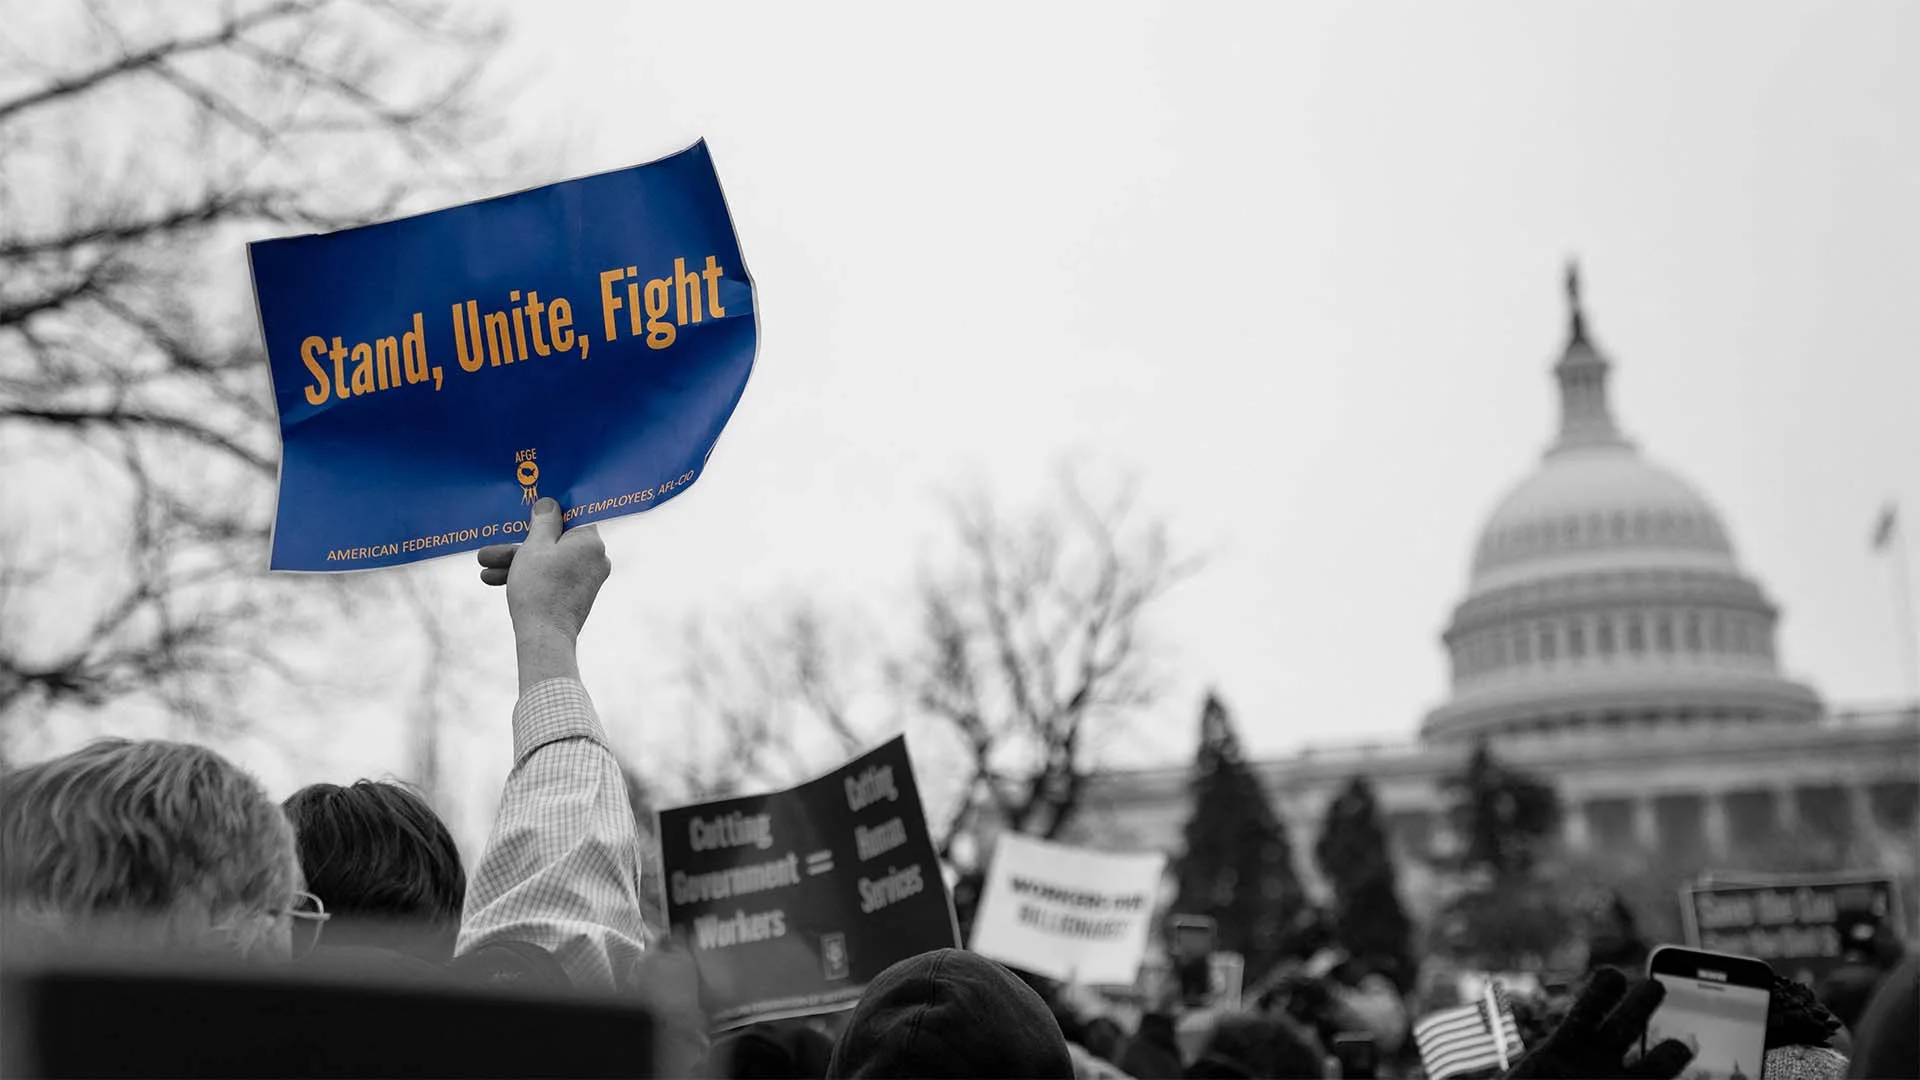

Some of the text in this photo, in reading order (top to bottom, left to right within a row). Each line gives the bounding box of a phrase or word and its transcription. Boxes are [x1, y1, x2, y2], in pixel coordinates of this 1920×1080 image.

[300, 255, 726, 406] Stand, Unite, Fight
[515, 448, 537, 464] AFGE
[326, 469, 695, 562] AMERICAN FEDERATION OF GOVENT EMPLOYEES, AFL-CIO
[694, 908, 786, 950] Workers
